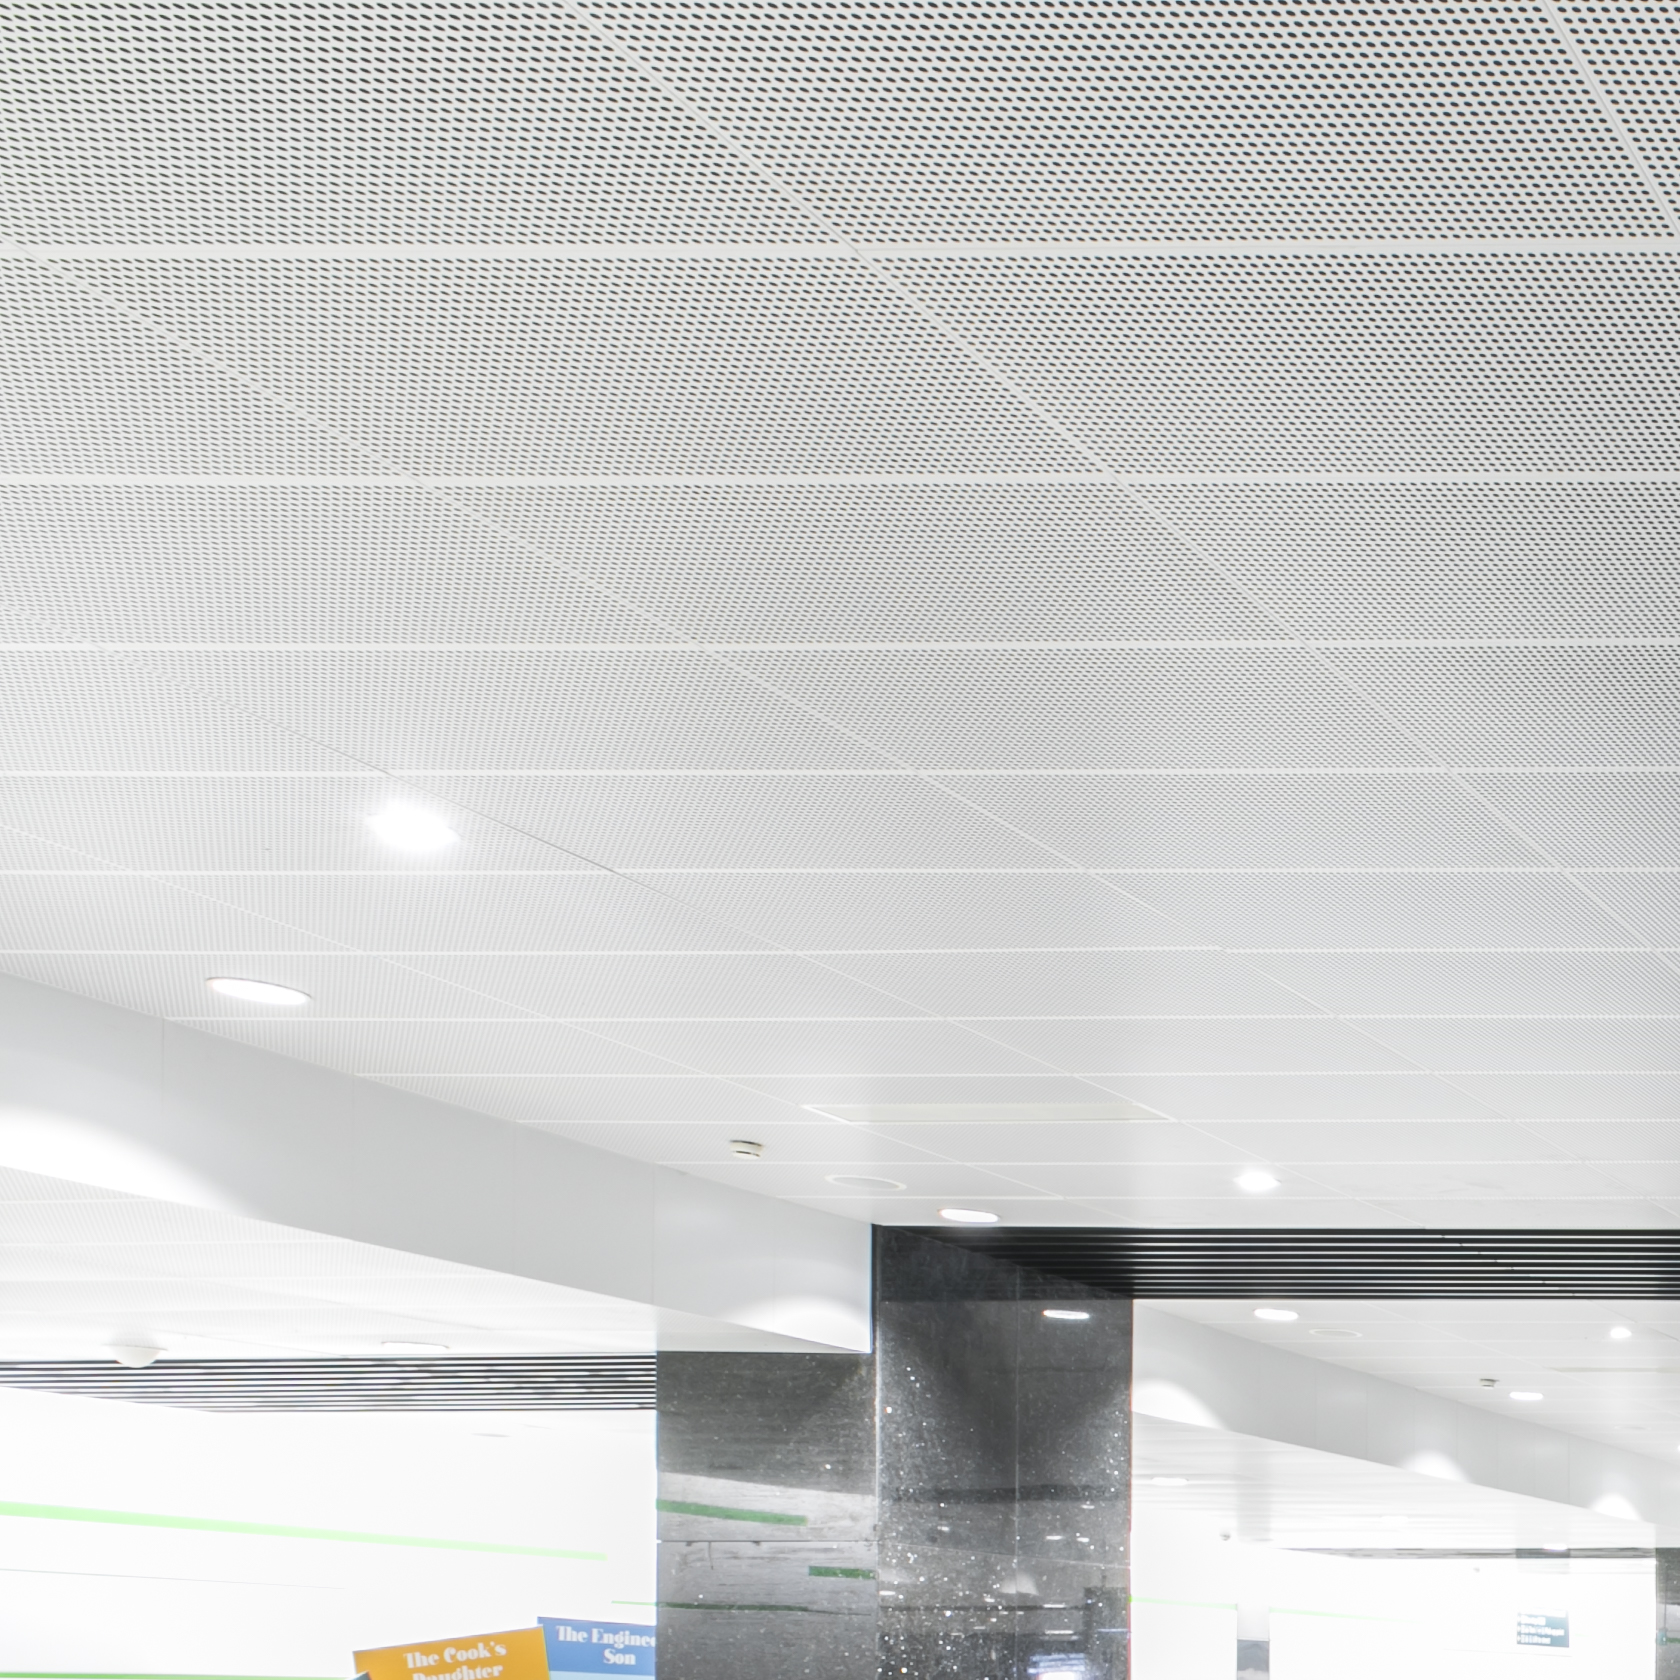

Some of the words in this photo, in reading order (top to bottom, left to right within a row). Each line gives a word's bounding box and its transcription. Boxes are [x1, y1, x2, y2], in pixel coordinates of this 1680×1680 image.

[556, 1625, 588, 1643] The
[403, 1652, 440, 1669] The
[443, 1641, 507, 1663] Cook's
[603, 1648, 636, 1665] Son
